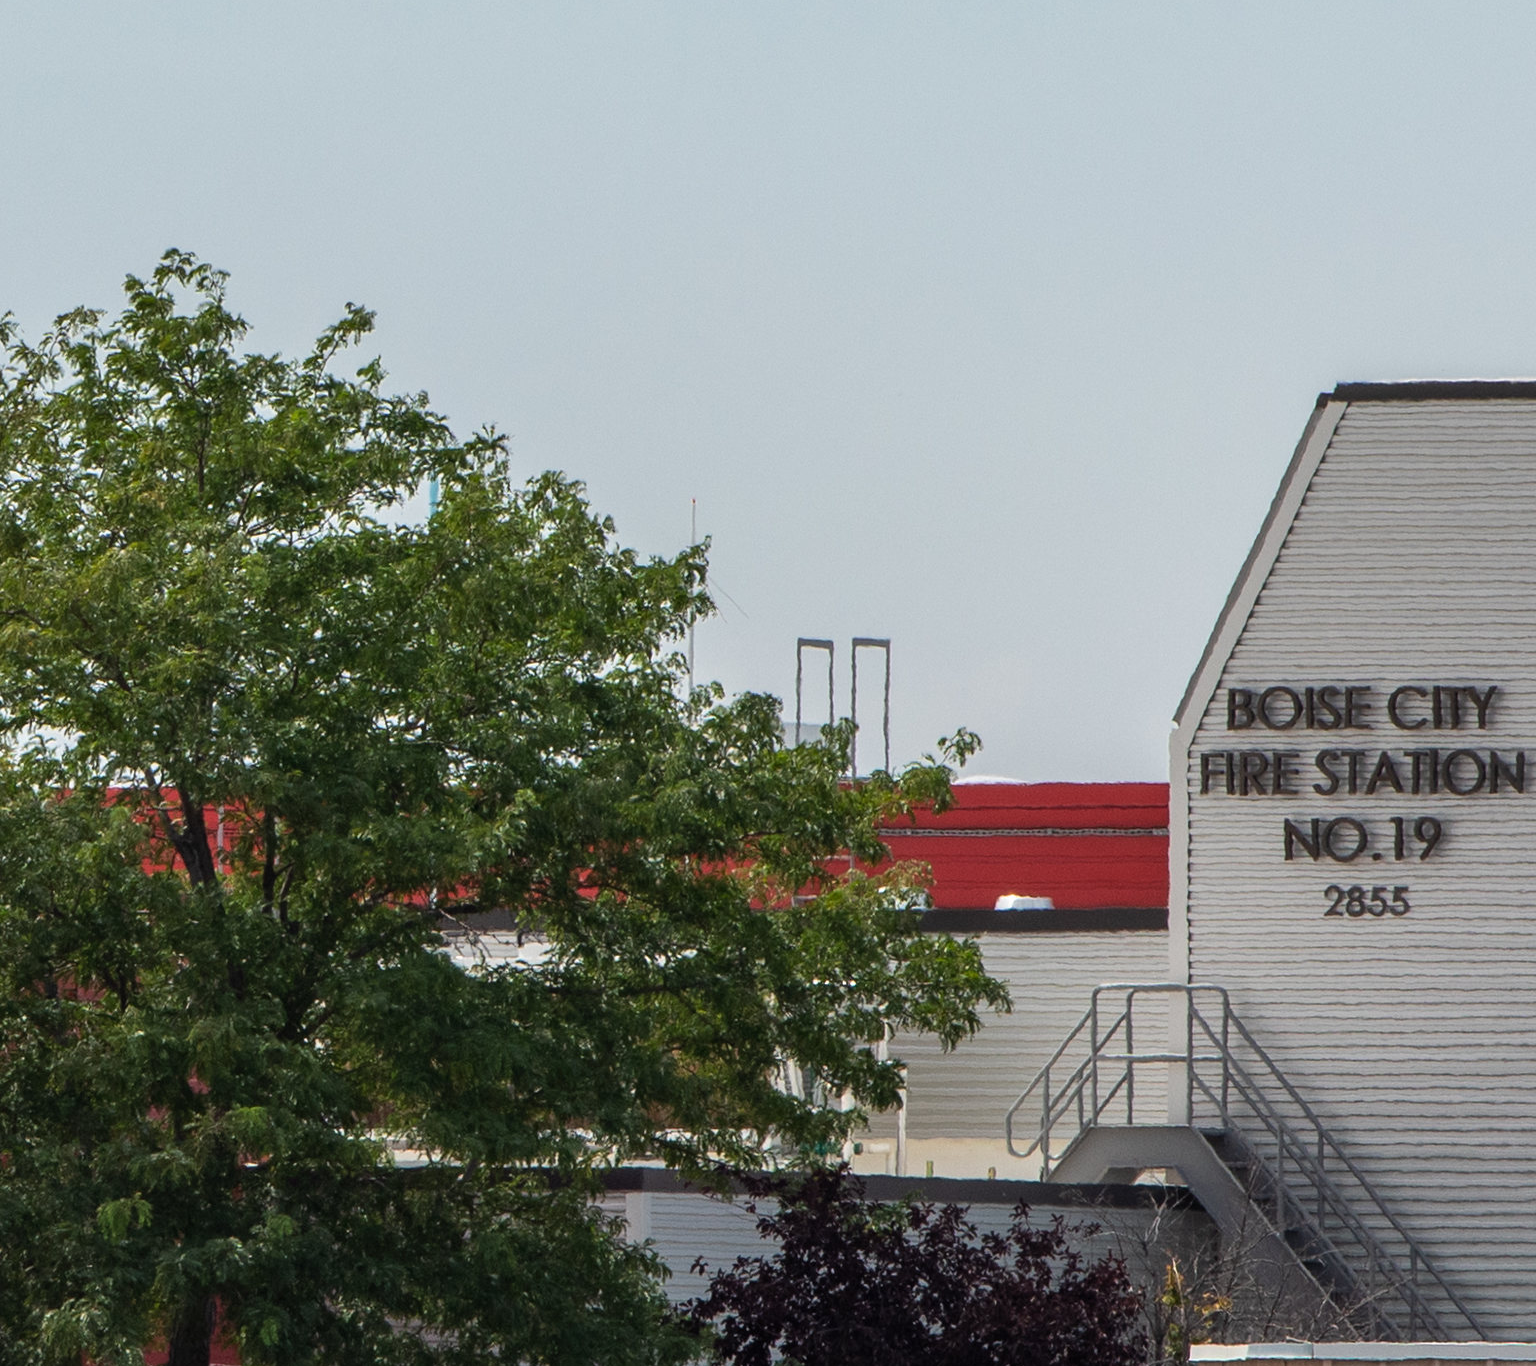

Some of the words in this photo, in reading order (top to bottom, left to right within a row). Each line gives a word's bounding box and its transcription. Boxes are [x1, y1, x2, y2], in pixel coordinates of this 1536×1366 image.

[1227, 685, 1371, 731] BOISE
[1387, 685, 1499, 730] CITY
[1200, 749, 1300, 795] FIRE
[1312, 748, 1525, 795] STATION
[1323, 885, 1411, 917] 2855
